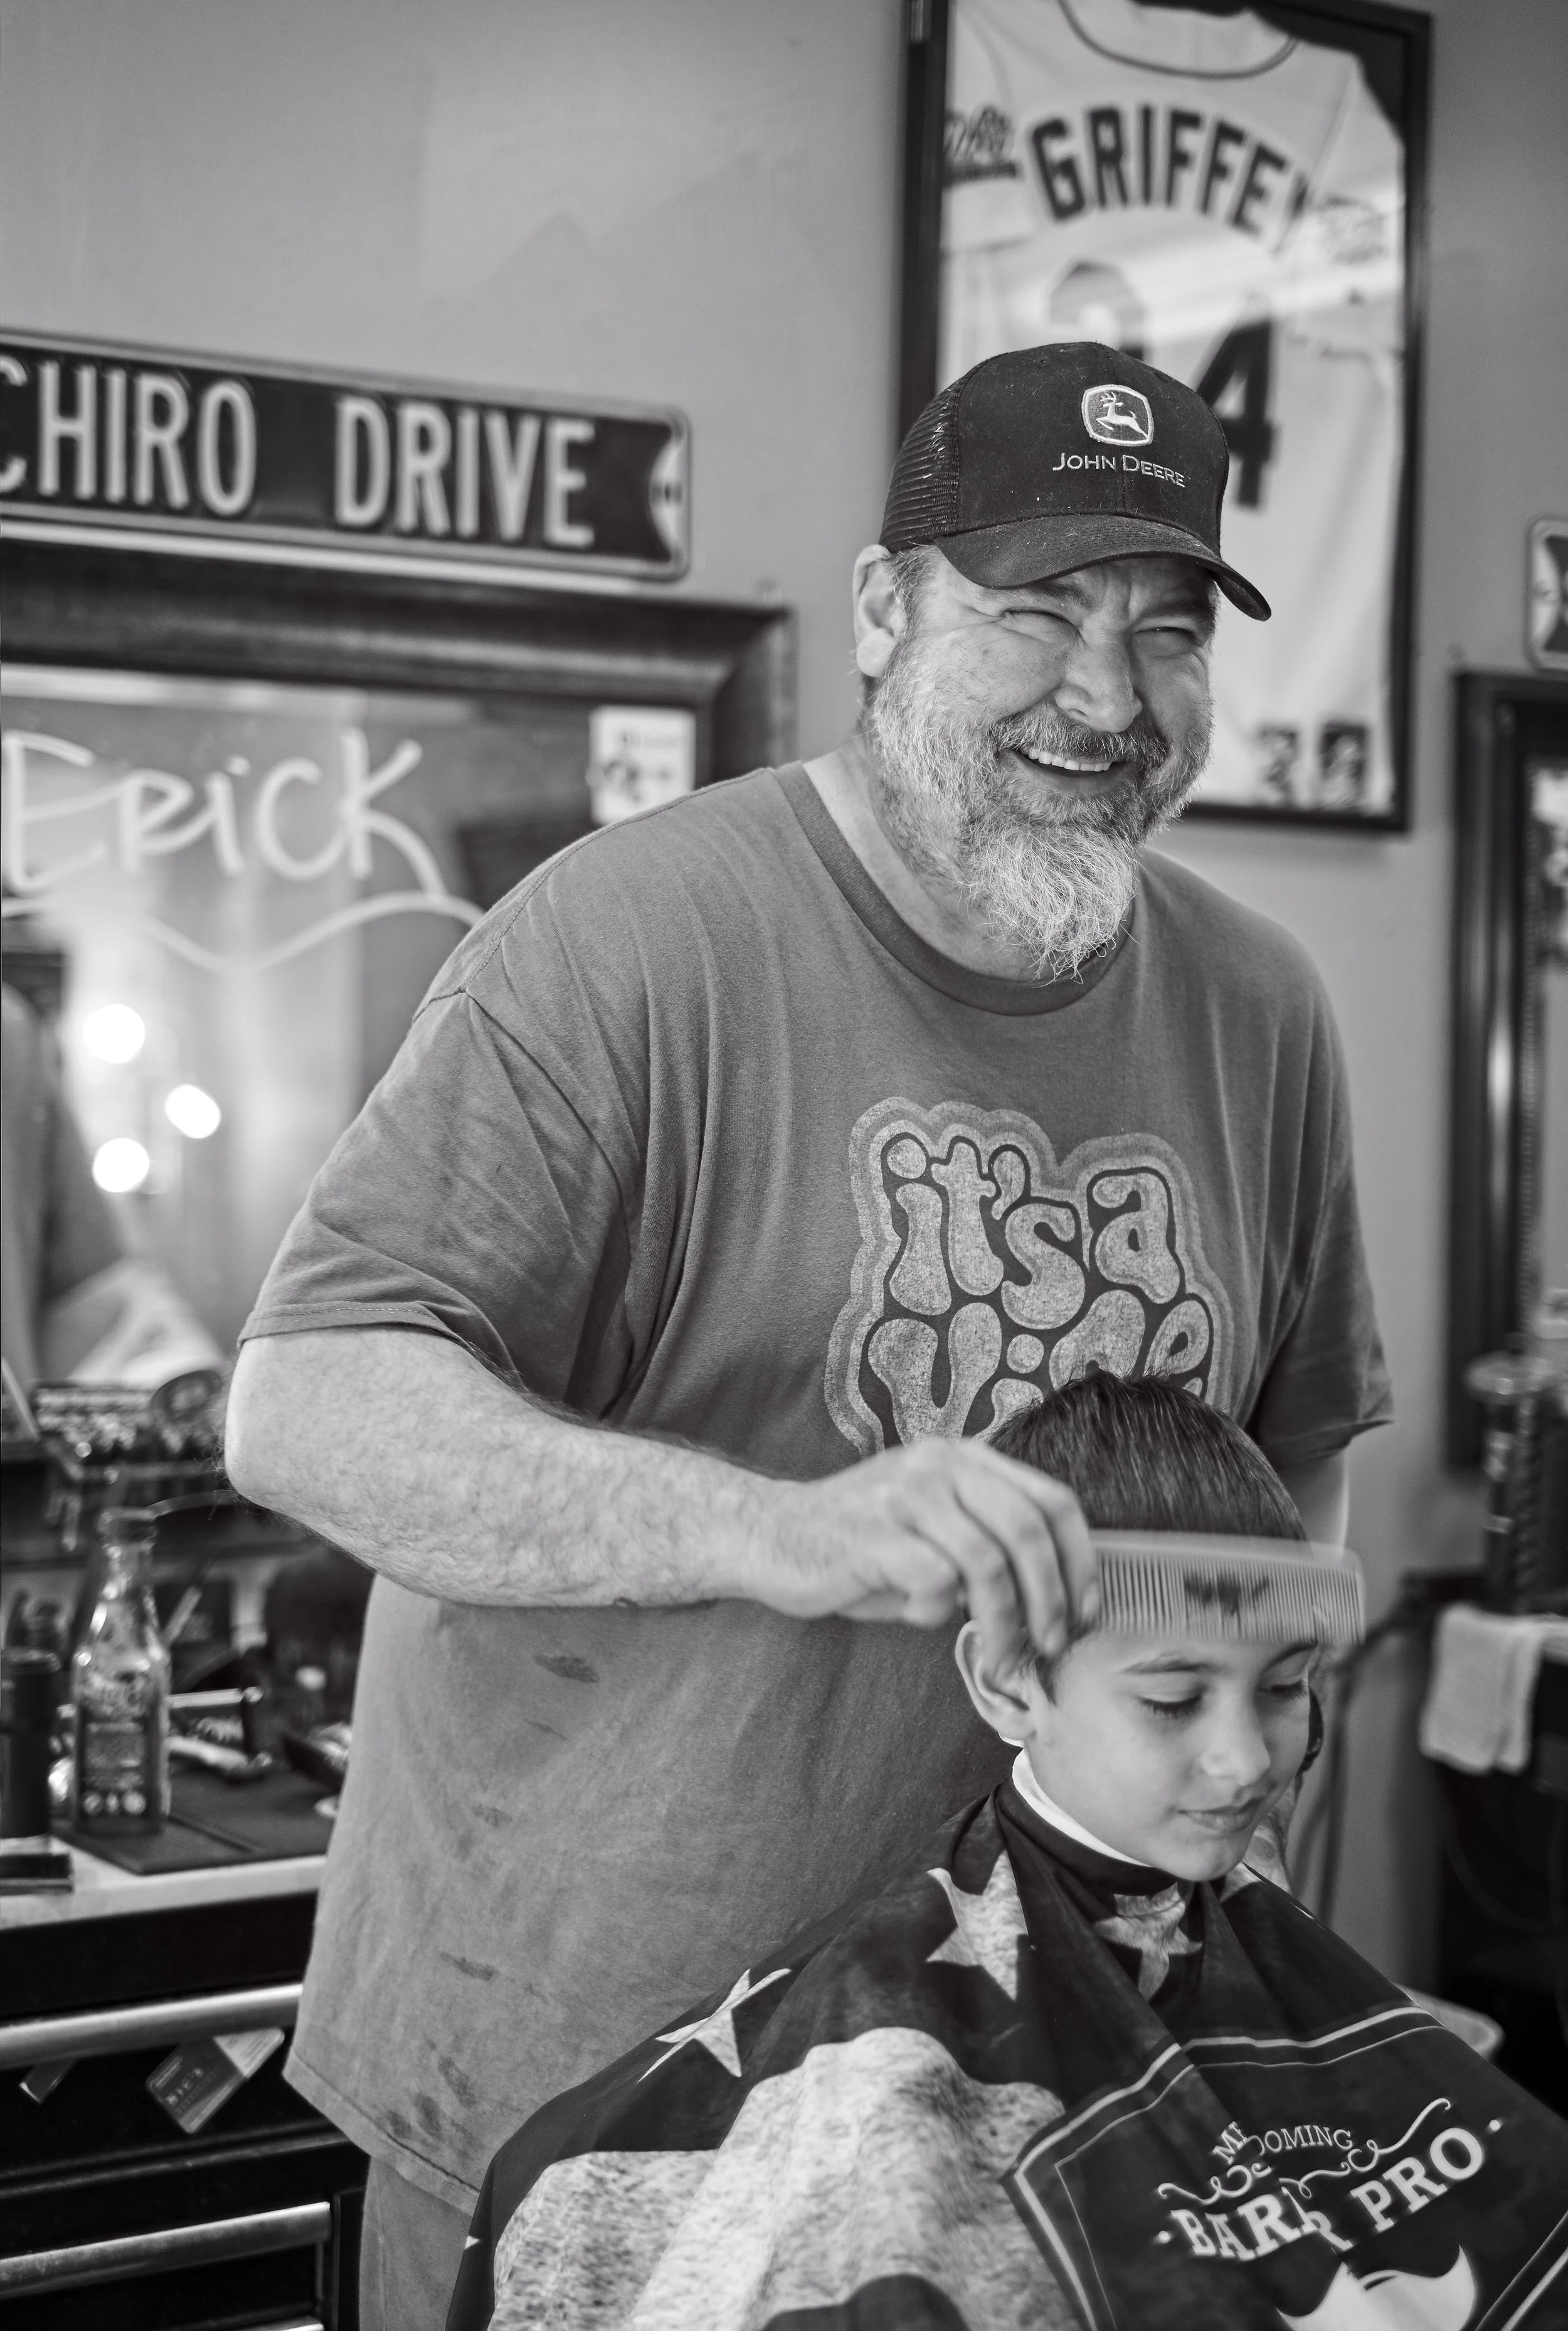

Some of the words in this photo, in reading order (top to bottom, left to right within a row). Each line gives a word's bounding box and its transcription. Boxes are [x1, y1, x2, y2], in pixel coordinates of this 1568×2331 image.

[334, 395, 595, 548] DRIVE
[1052, 452, 1117, 472] JOHN
[1122, 454, 1186, 488] DEERE
[1349, 2127, 1484, 2234] PRO
